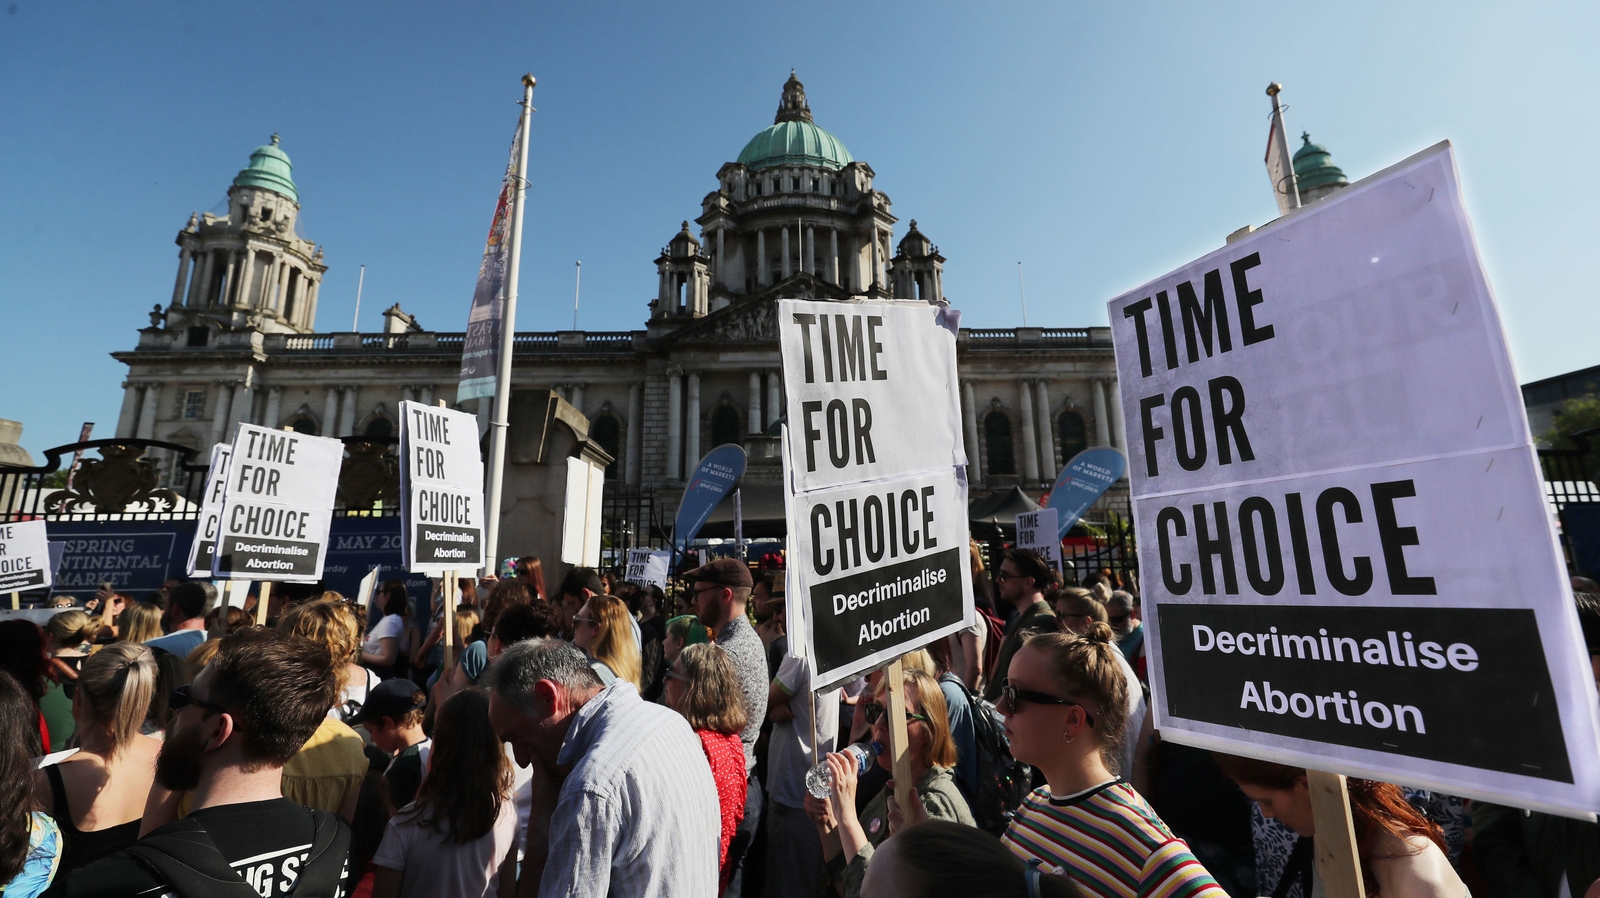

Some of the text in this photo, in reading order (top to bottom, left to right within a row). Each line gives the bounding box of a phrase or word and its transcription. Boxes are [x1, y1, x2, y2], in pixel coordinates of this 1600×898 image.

[1123, 251, 1275, 378] TIME
[793, 313, 888, 384] TIME
[413, 409, 451, 445] TIME
[802, 398, 876, 472] FOR
[1139, 375, 1255, 478] FOR
[247, 430, 298, 465] TIME
[416, 447, 445, 479] FOR
[713, 463, 733, 473] WORLD
[1087, 463, 1111, 475] WORLD
[237, 464, 281, 496] FOR
[1083, 468, 1114, 483] MARKETS
[419, 489, 471, 525] CHOICE
[230, 504, 309, 539] CHOICE
[1018, 514, 1039, 529] TIME
[425, 530, 474, 543] Decriminalise
[810, 485, 937, 576] CHOICE
[1020, 530, 1035, 544] FOR
[1156, 479, 1438, 596] CHOICE
[65, 539, 135, 553] SPRING
[235, 542, 309, 556] Decriminalise
[336, 535, 376, 549] MAY
[434, 548, 466, 558] Abortion
[632, 552, 652, 563] TIME
[1, 556, 33, 573] OICE
[59, 555, 162, 570] NTINENTAL
[245, 558, 294, 570] Abortion
[628, 564, 645, 576] FOR
[55, 571, 132, 586] MARKET
[406, 579, 427, 588] 6pm
[832, 568, 947, 616] Decriminalise
[858, 607, 930, 646] Abortion
[1192, 624, 1479, 672] Decriminalise
[1240, 681, 1427, 735] Abortion
